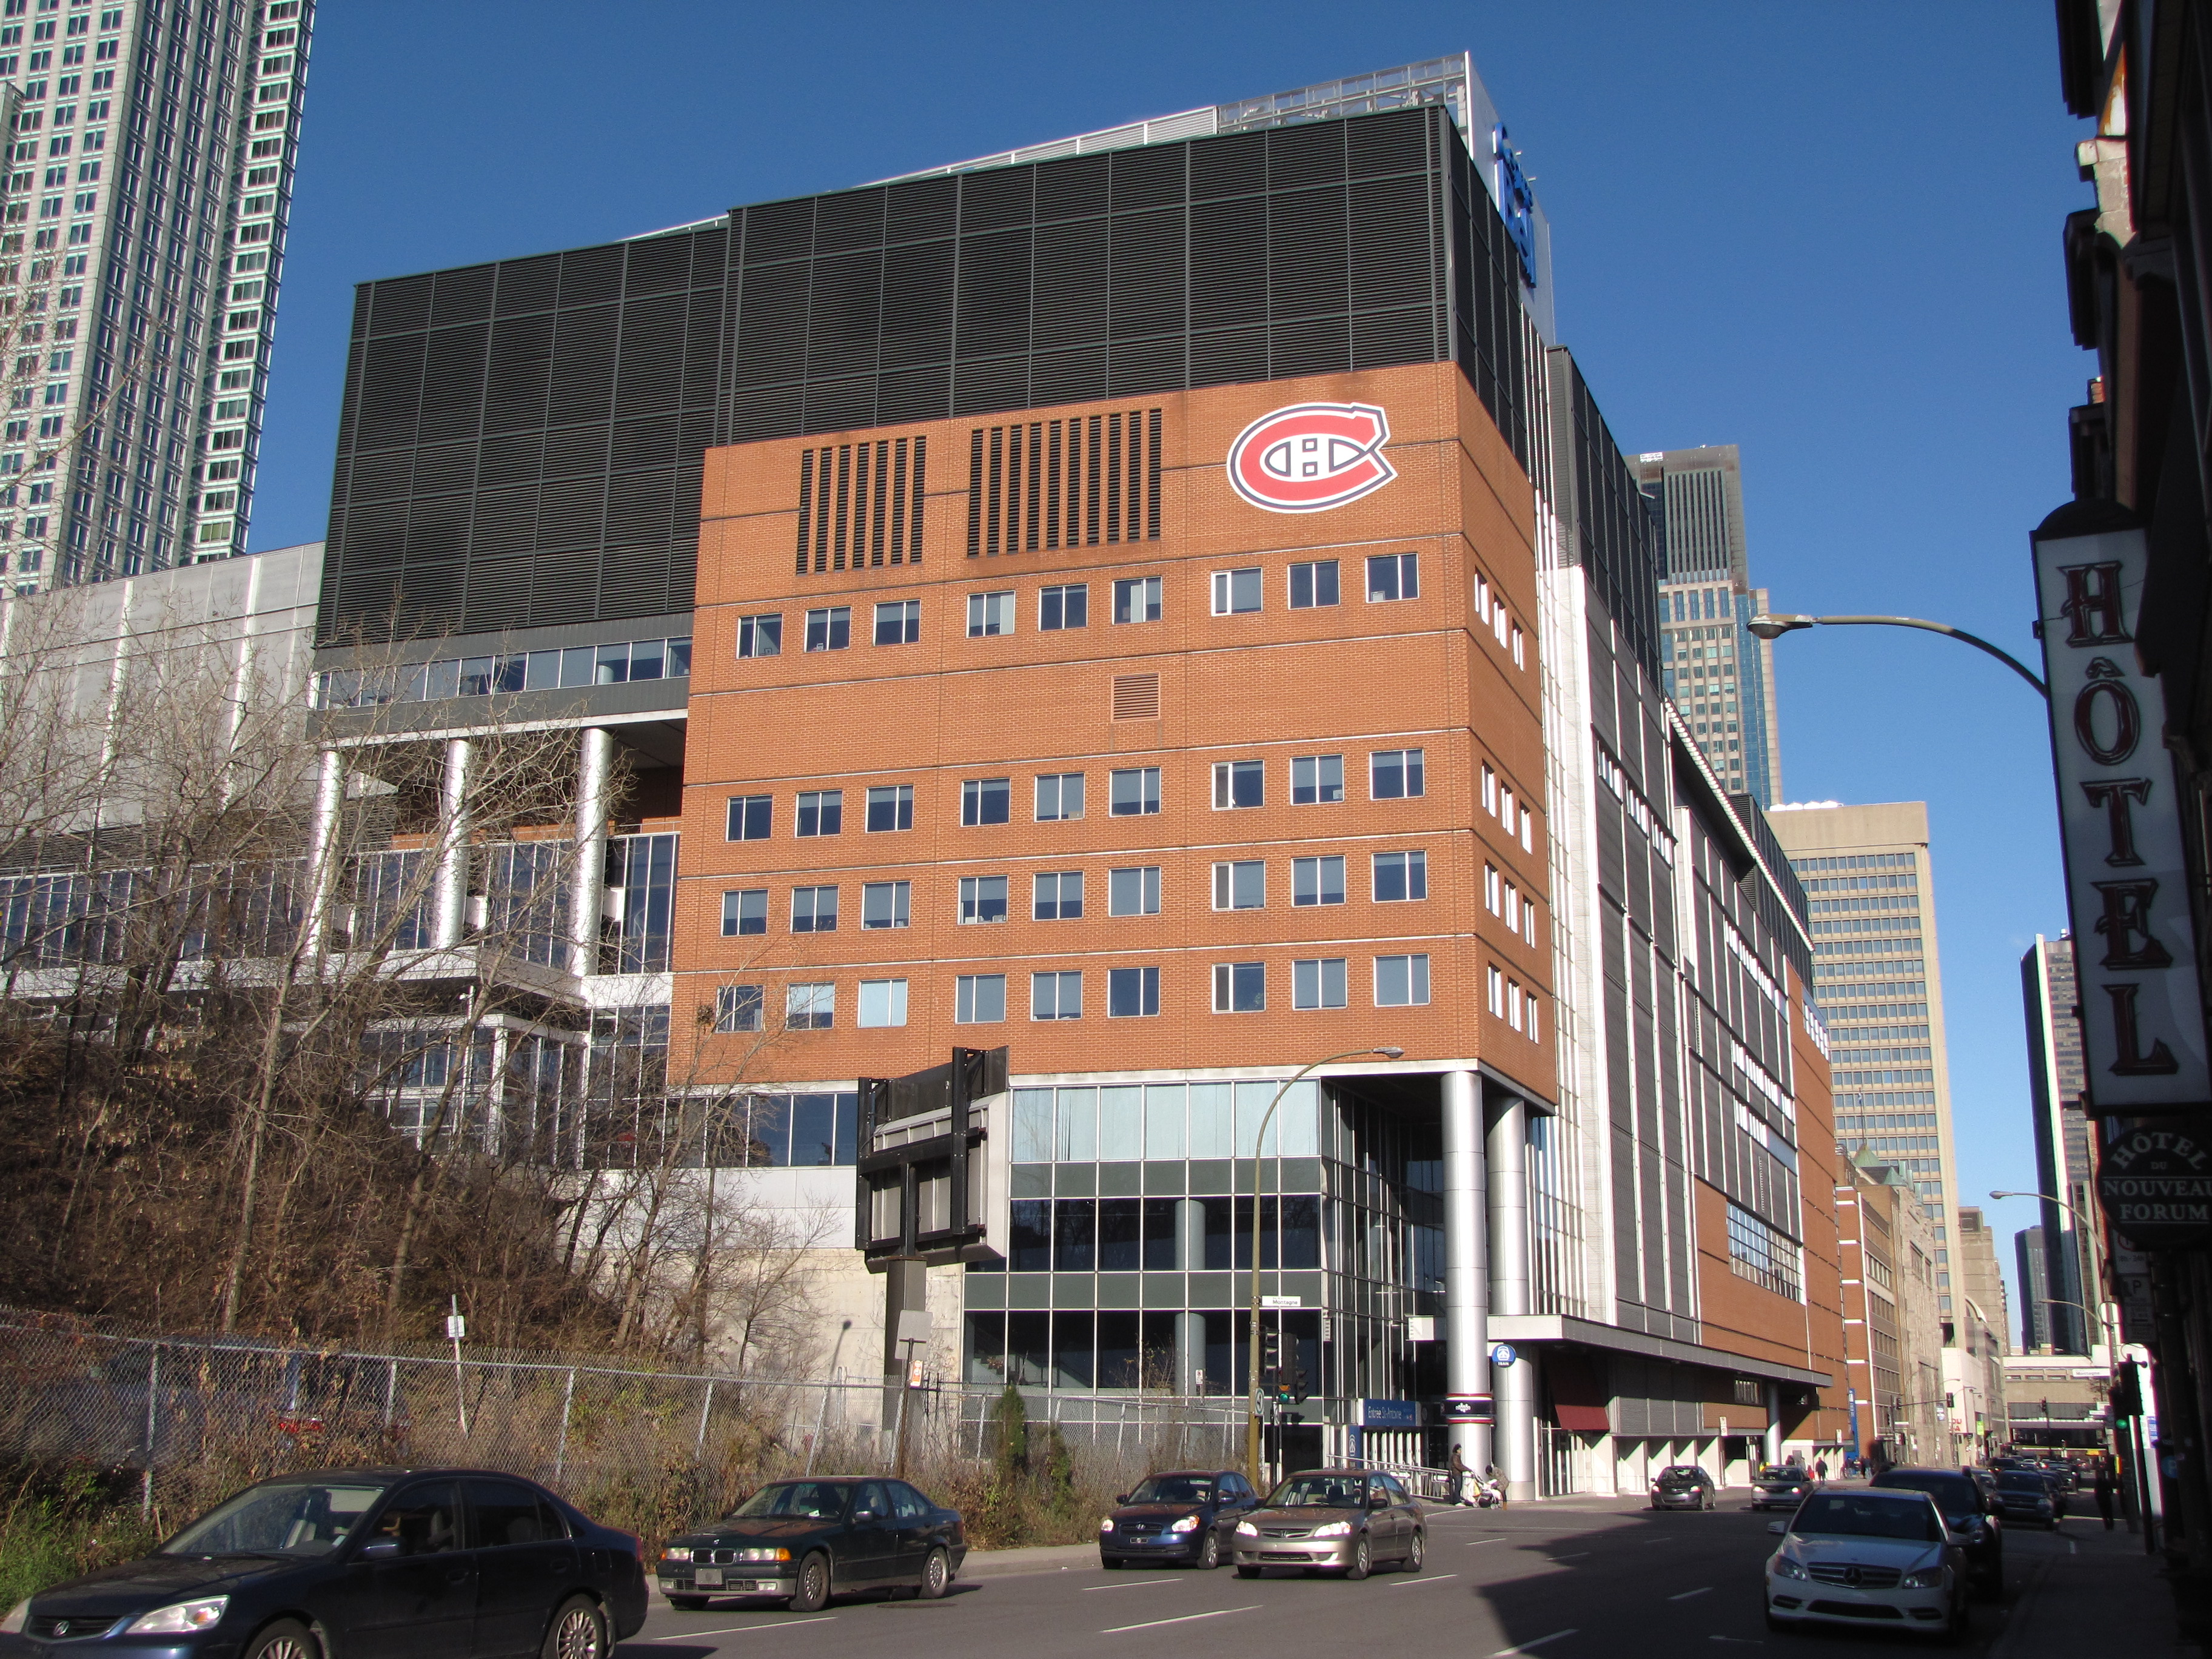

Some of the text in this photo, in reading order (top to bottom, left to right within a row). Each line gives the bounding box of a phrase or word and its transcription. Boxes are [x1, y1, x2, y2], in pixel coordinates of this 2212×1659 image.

[2058, 560, 2179, 1076] HÔTEL
[2111, 1132, 2207, 1170] HÔTEL
[2150, 1161, 2168, 1170] DU
[2120, 1204, 2210, 1220] FORUM
[1368, 1406, 1382, 1419] Entrée
